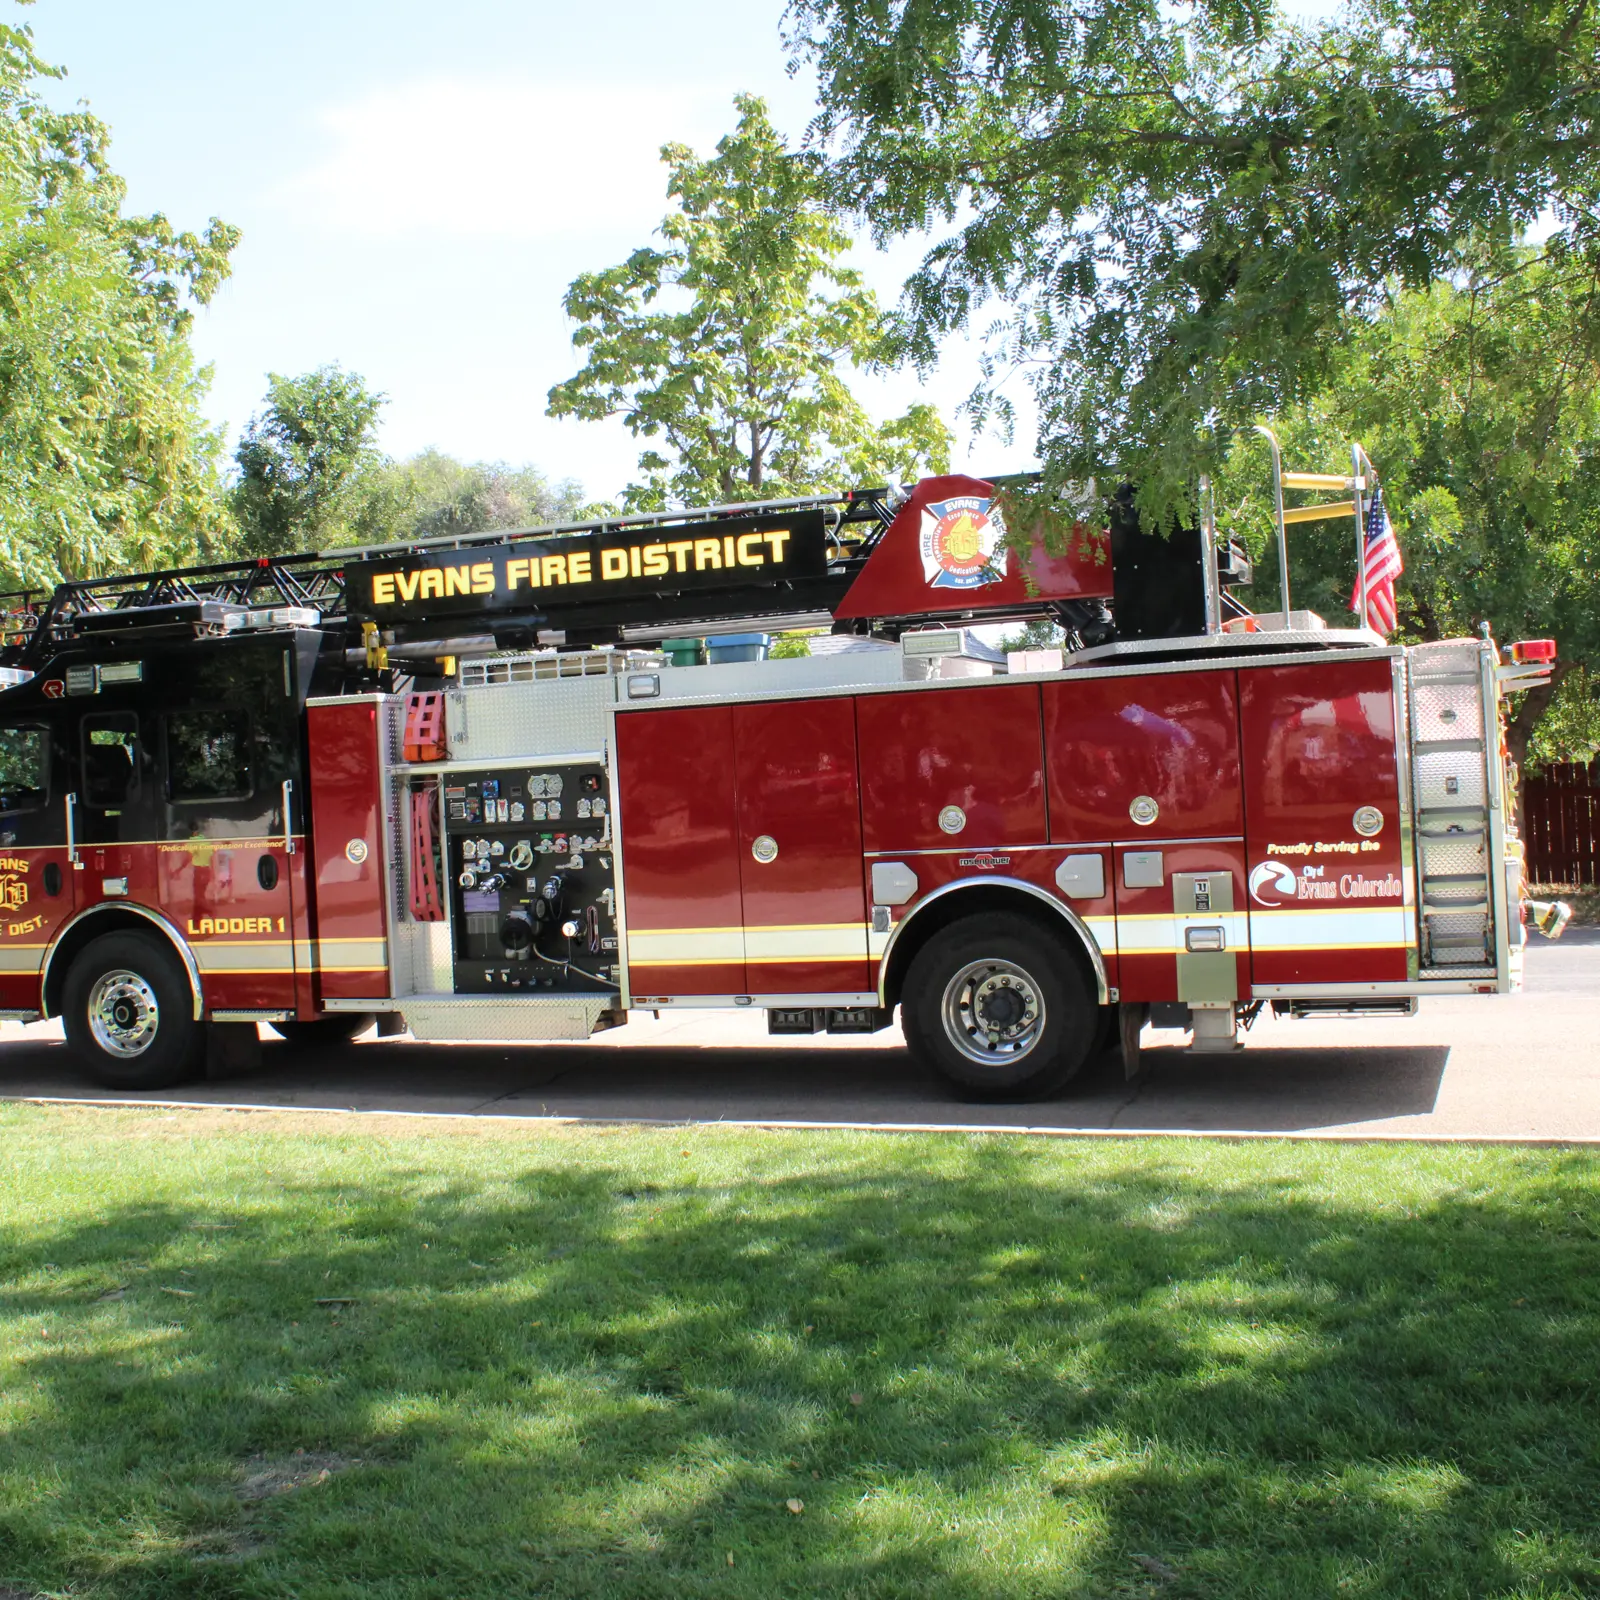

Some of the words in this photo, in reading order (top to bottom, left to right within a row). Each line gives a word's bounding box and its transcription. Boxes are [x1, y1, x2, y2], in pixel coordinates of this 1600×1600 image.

[945, 499, 980, 512] EVANS
[923, 533, 933, 558] FIRE
[373, 563, 496, 604] EVANS
[506, 552, 591, 590] FIRE
[602, 530, 790, 581] DISTRICT
[1267, 842, 1313, 855] Proudly
[1314, 841, 1359, 854] Serving
[1361, 840, 1381, 851] the
[959, 857, 1010, 866] rosenbauer
[1303, 866, 1316, 878] City
[1316, 865, 1325, 876] of
[1297, 876, 1337, 900] Evans
[1340, 873, 1402, 899] Colorado
[8, 914, 49, 936] DIST.
[187, 917, 272, 935] LADDER
[277, 916, 285, 933] 1
